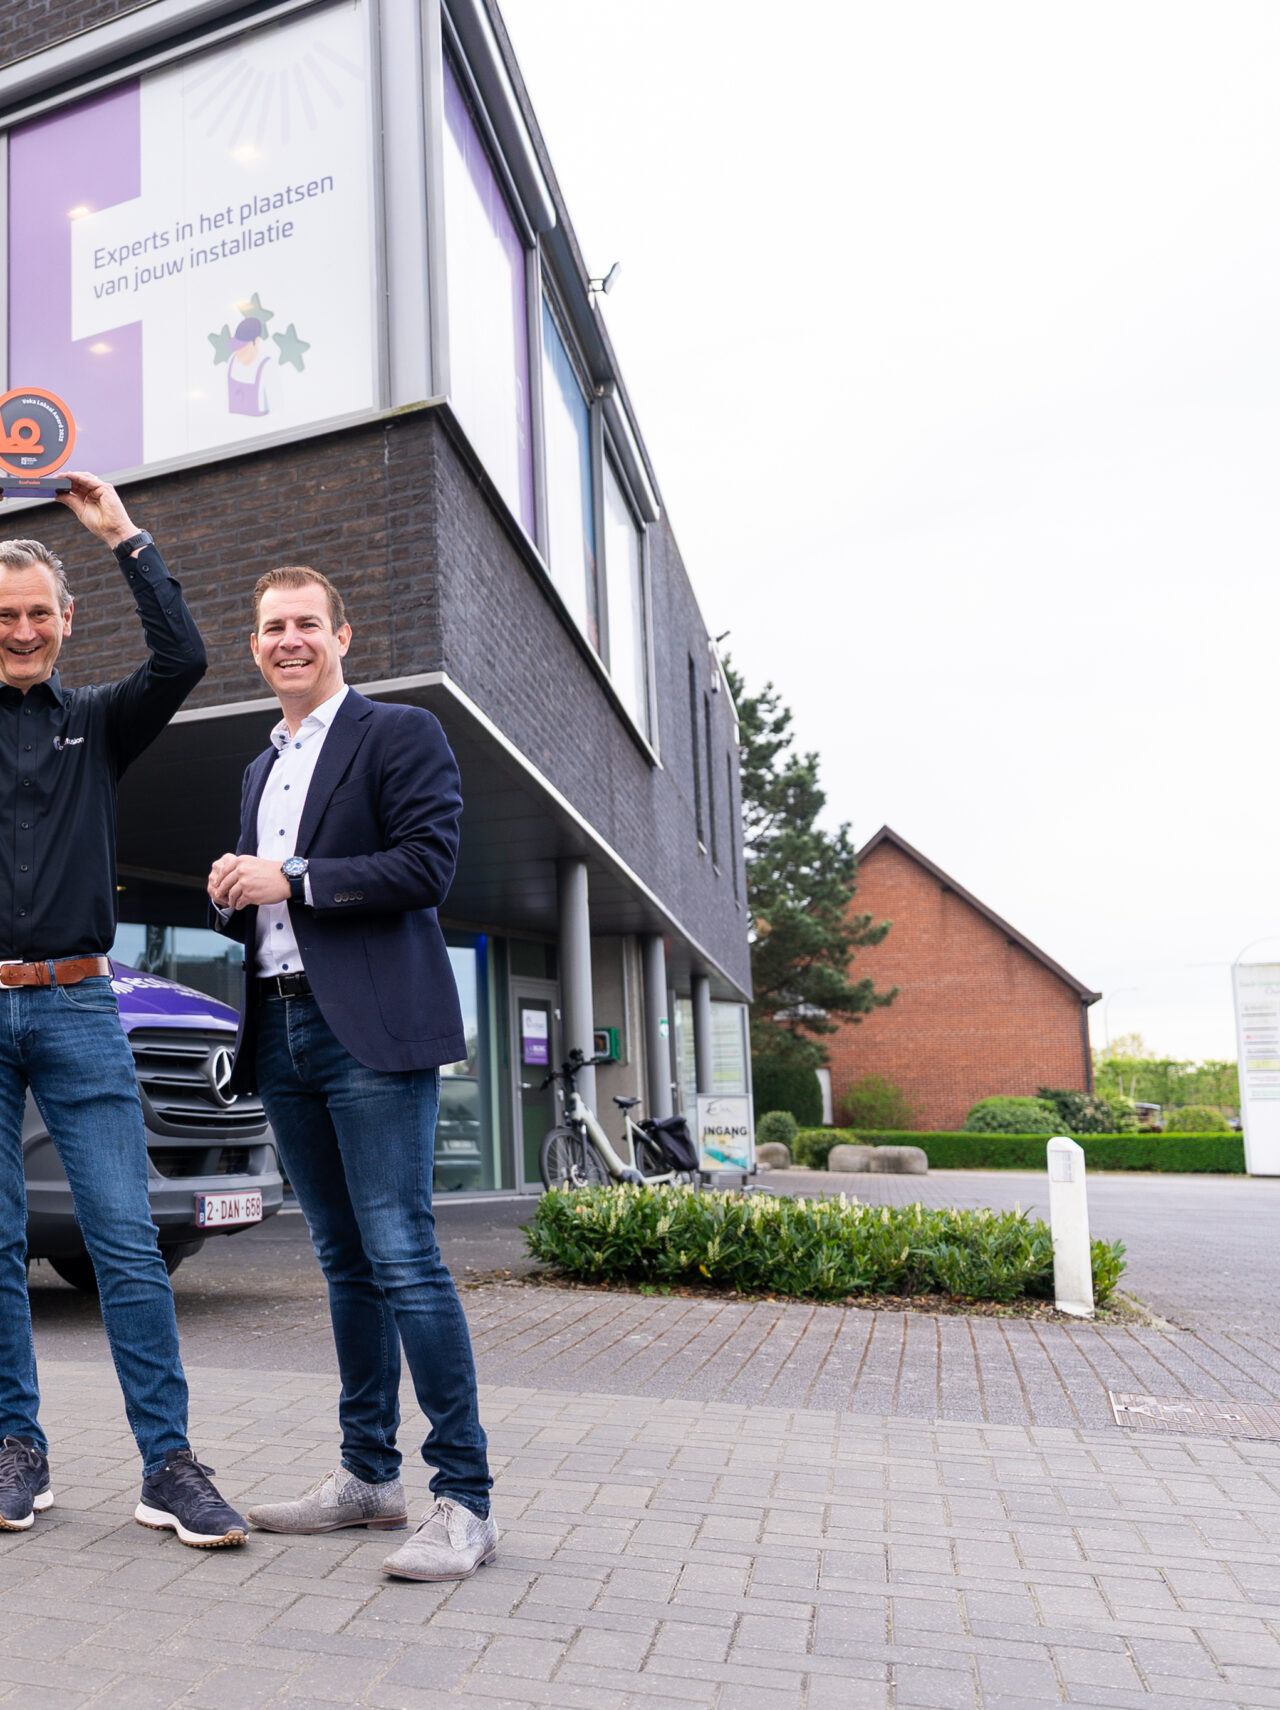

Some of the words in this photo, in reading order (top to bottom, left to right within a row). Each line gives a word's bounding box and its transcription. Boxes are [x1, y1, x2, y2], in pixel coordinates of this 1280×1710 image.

[93, 230, 170, 270] Experts
[175, 221, 194, 243] in
[199, 206, 233, 234] het
[239, 175, 334, 226] plaatsen
[93, 275, 128, 299] van
[133, 256, 184, 292] jouw
[189, 220, 294, 269] installatie
[703, 1126, 748, 1136] INGANG
